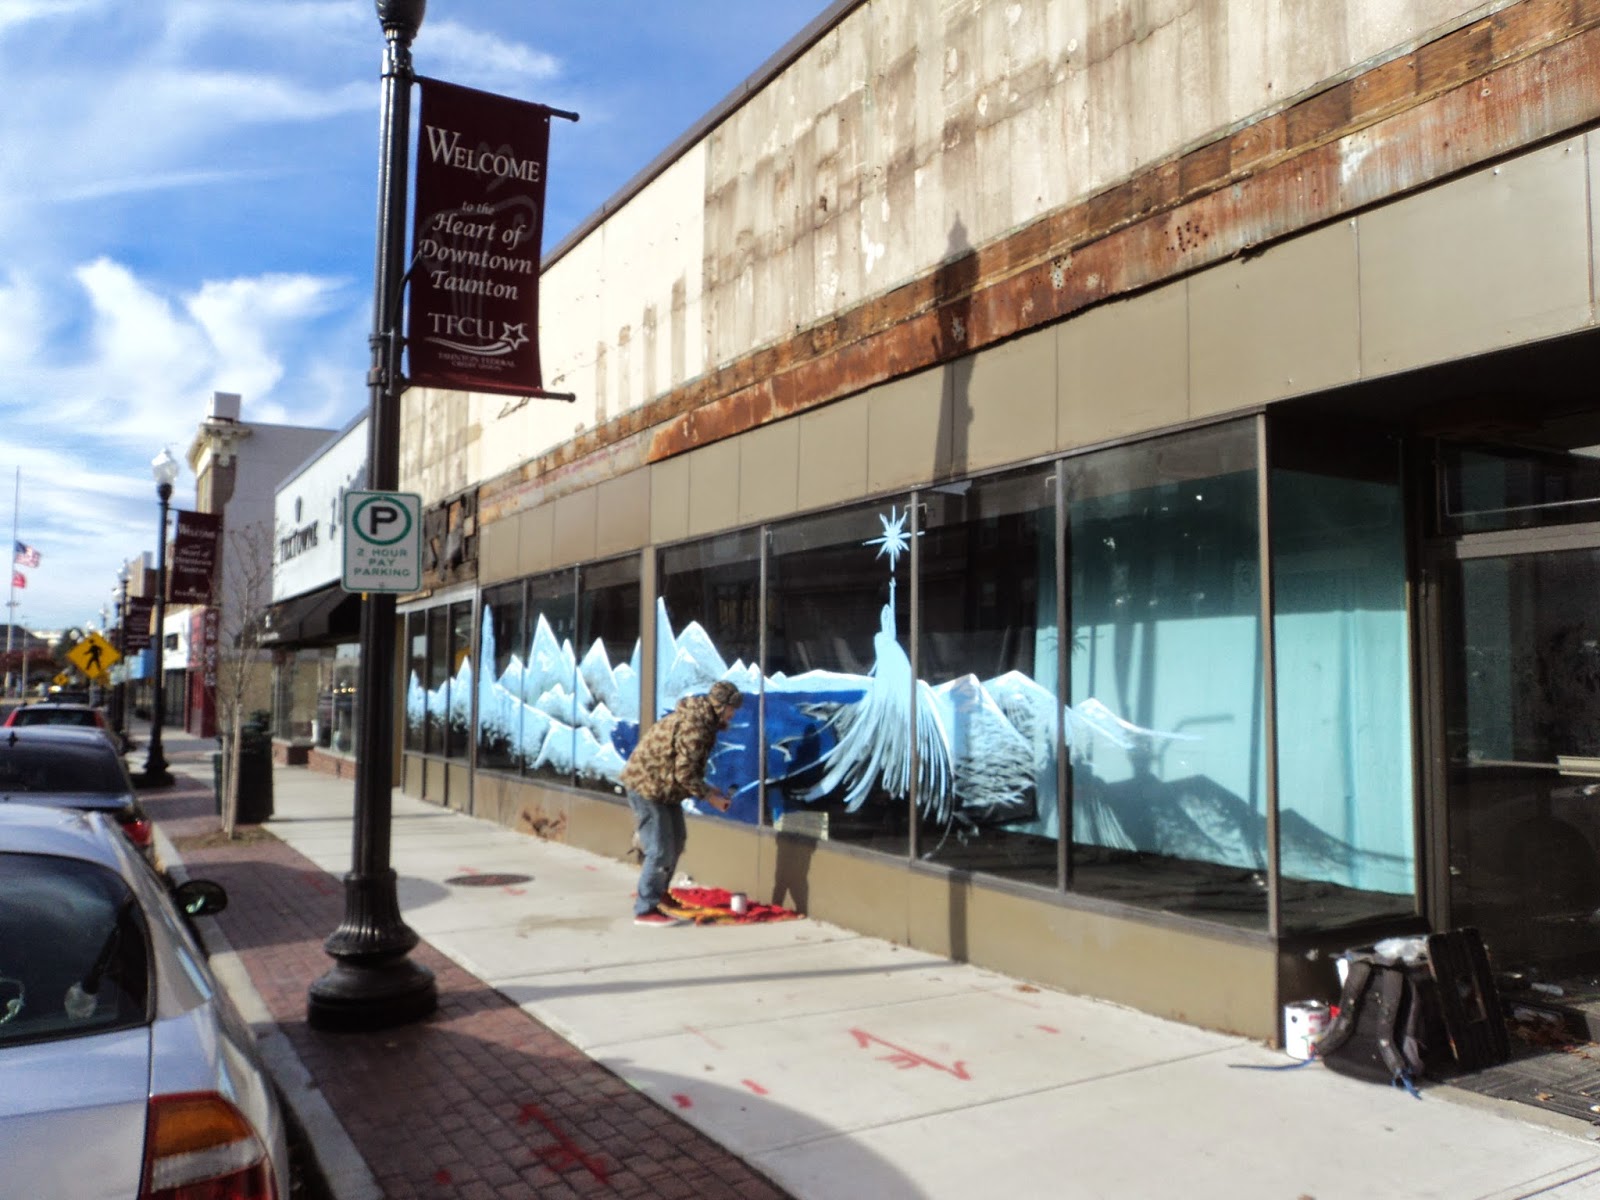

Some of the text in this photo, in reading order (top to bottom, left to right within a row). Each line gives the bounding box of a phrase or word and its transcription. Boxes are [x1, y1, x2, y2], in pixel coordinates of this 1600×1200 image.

[426, 125, 540, 182] WELCOME
[462, 201, 495, 215] to the
[432, 213, 527, 251] Heart of
[419, 239, 532, 274] Downtown
[431, 270, 518, 300] Taunton
[427, 312, 494, 340] TFCU
[370, 506, 398, 535] P
[356, 548, 408, 557] 2 HOUR
[368, 558, 396, 567] PAY
[353, 567, 411, 577] PARKING
